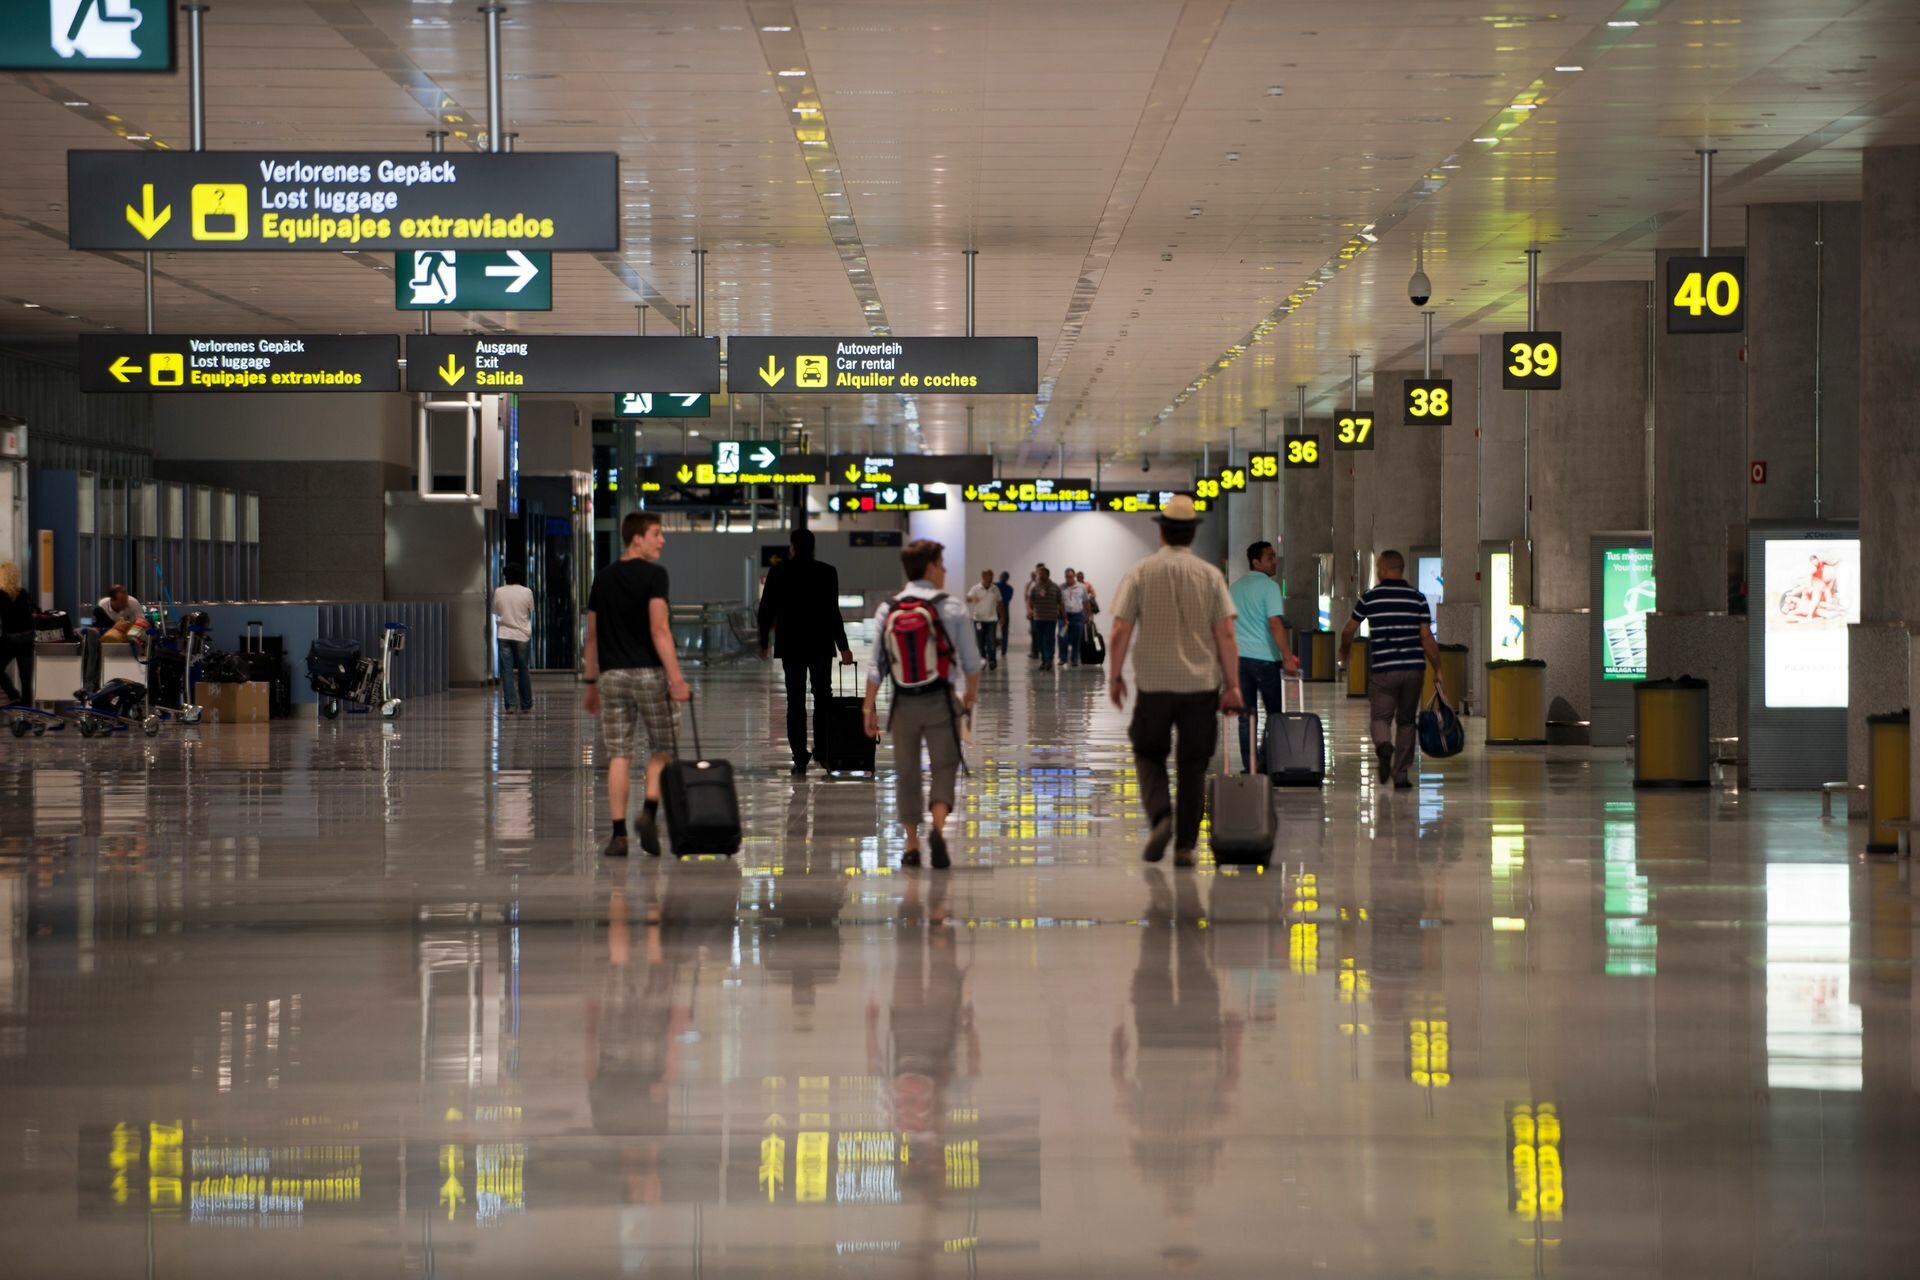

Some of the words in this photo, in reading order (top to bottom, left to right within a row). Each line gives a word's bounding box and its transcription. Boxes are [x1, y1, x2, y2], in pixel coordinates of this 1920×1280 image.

[260, 160, 371, 183] Verlorenes
[378, 160, 456, 186] Gepäck
[261, 187, 308, 209] Lost
[314, 187, 398, 213] luggage
[262, 213, 391, 243] Equipajes
[399, 213, 554, 238] extraviados
[1674, 271, 1740, 316] 40
[190, 340, 255, 352] Verlorenes
[259, 340, 304, 354] Gepäck
[476, 341, 528, 356] Ausgang
[836, 342, 902, 355] Autoverleih
[191, 356, 218, 368] Lost
[221, 356, 270, 370] luggage
[476, 356, 499, 369] Exit
[836, 357, 857, 370] Car
[861, 358, 894, 370] rental
[1509, 342, 1558, 377] 39
[191, 370, 266, 387] Equipajes
[271, 371, 362, 385] extraviados
[476, 371, 524, 386] Salida
[836, 372, 895, 389] Alquiler
[900, 372, 918, 387] de
[924, 372, 977, 387] coches
[1409, 388, 1449, 417] 38
[1338, 418, 1372, 444] 37
[1288, 440, 1318, 463] 36
[1251, 456, 1277, 477] 35
[739, 473, 772, 485] Alquiler
[1196, 479, 1219, 498] 33
[1220, 470, 1245, 489] 34
